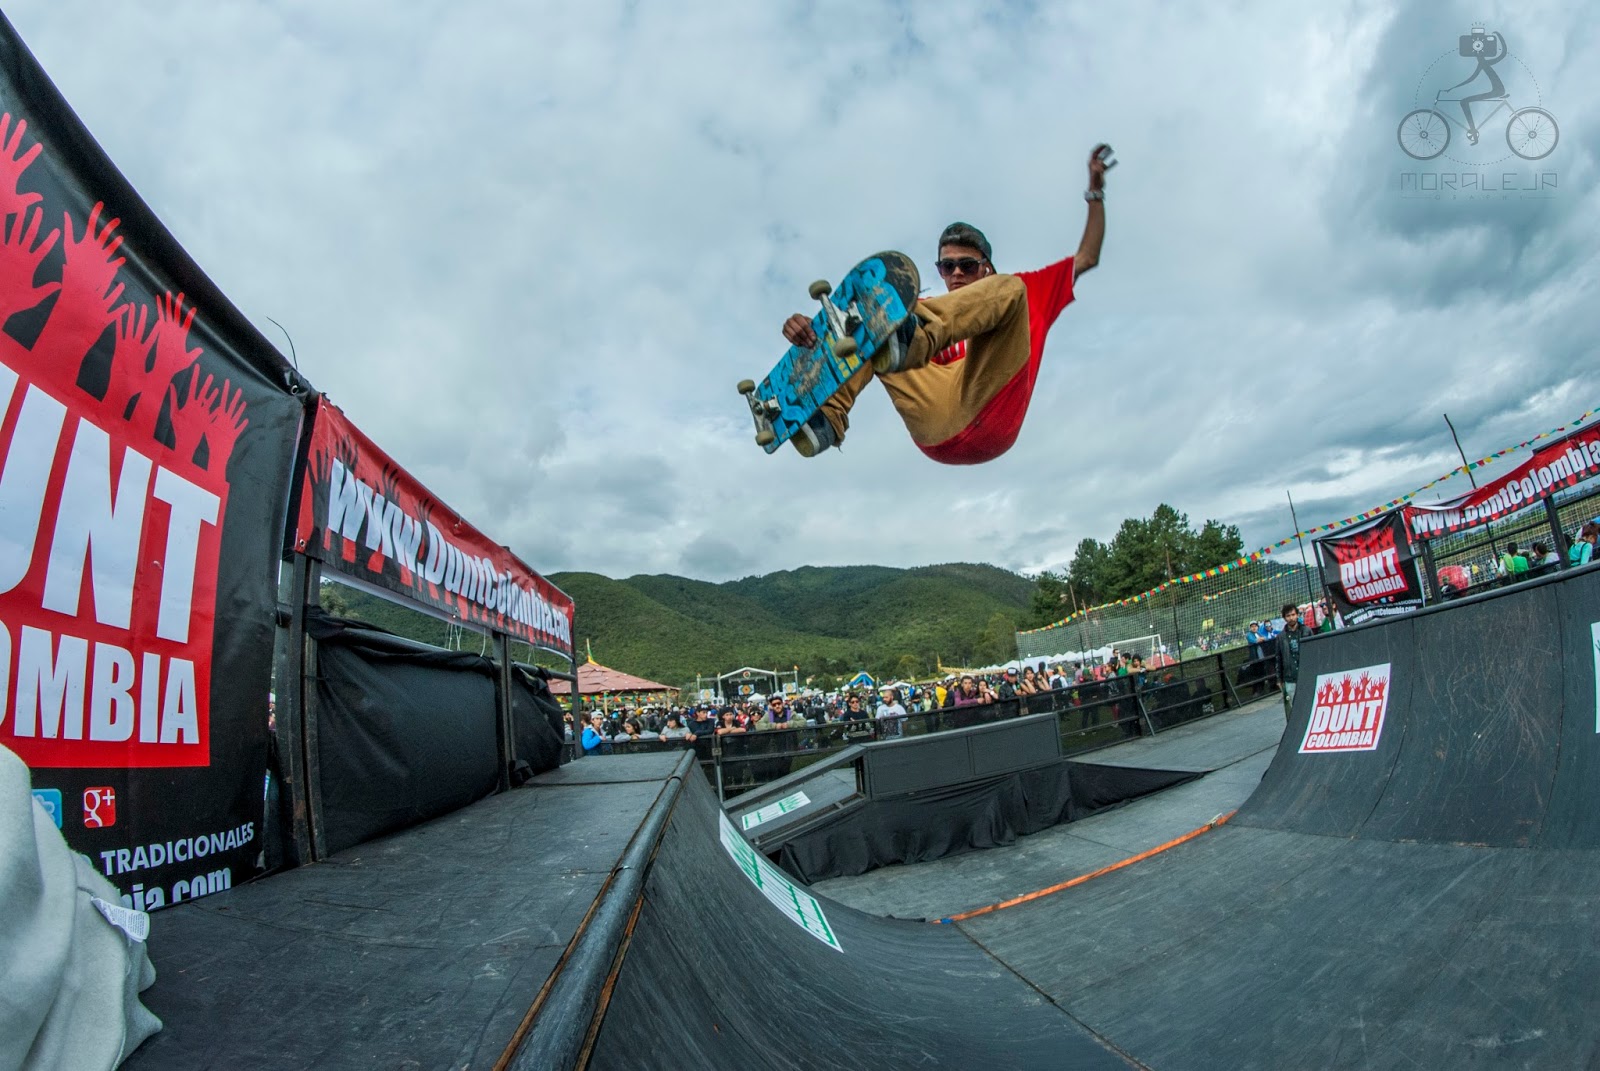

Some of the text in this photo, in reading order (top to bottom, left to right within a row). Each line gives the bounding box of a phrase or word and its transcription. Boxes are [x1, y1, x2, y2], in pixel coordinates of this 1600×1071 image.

[1340, 547, 1396, 588] DUNT
[1347, 574, 1405, 601] COLOMBIA
[0, 622, 200, 745] MBIA
[1311, 700, 1383, 734] DUNT
[1306, 730, 1374, 749] COLOMBIA
[101, 822, 254, 876] TRADICIONALES
